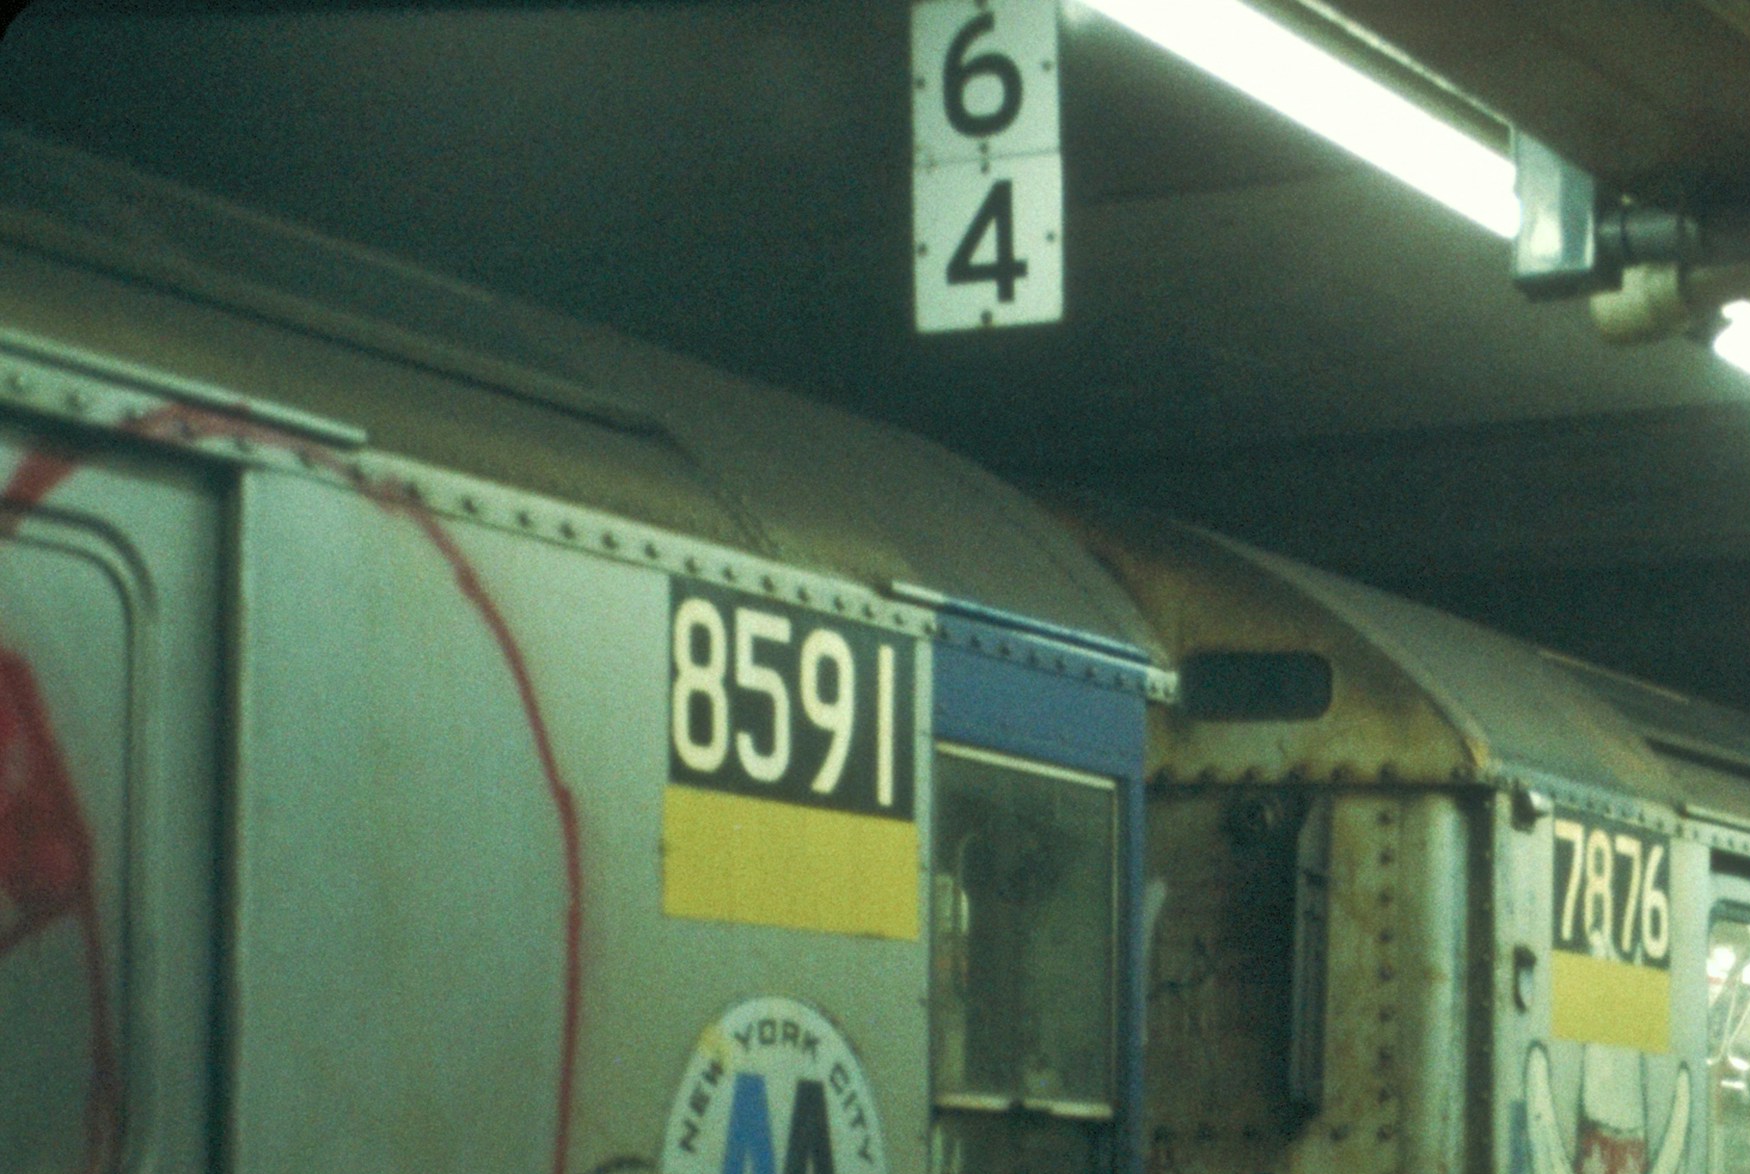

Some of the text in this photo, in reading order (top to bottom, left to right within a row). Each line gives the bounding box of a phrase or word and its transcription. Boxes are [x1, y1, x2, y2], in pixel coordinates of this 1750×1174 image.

[942, 10, 1024, 138] 6
[945, 178, 1028, 303] 4
[671, 598, 895, 807] 8591
[1555, 818, 1669, 960] 7876
[678, 1018, 876, 1166] NEW YORK CITY
